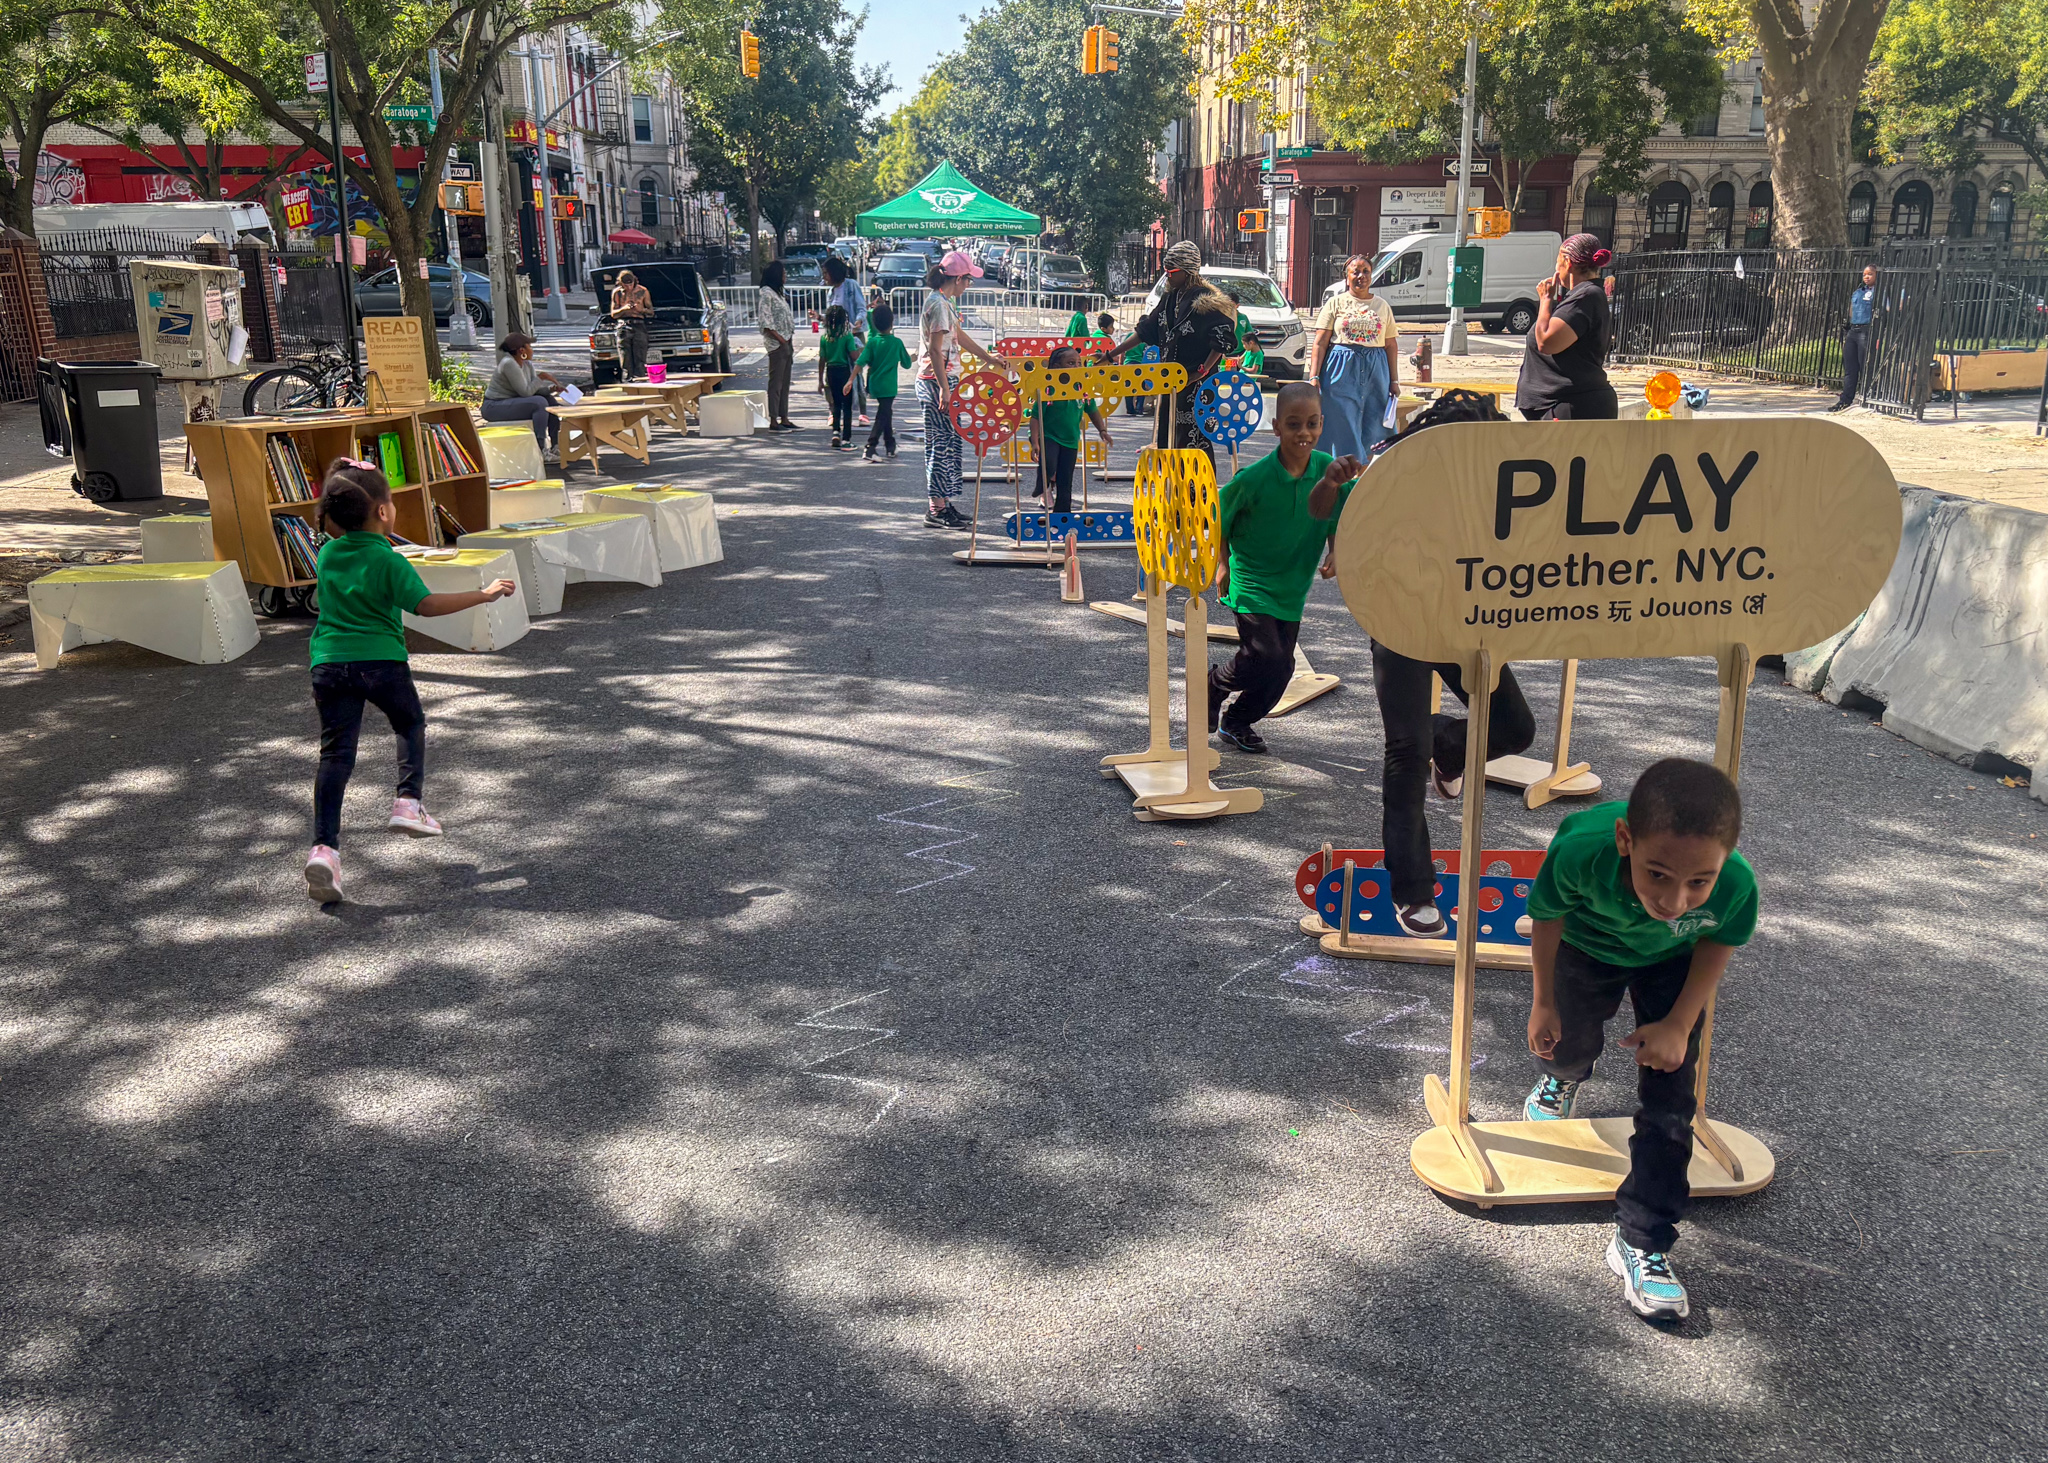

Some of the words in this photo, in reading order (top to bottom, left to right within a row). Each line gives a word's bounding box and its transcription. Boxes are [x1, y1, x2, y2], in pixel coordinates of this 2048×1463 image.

[1281, 149, 1303, 157] Saratoga
[1406, 190, 1427, 199] Deeper
[1428, 190, 1439, 198] Life
[287, 202, 309, 226] EBT
[873, 222, 906, 231] Together
[920, 222, 949, 230] STRIVE,
[949, 222, 982, 231] together
[367, 321, 418, 335] READ
[384, 363, 402, 371] Street
[1494, 450, 1759, 541] PLAY
[1456, 552, 1658, 598] Together.
[1675, 546, 1775, 583] NYC.
[1464, 603, 1599, 629] Juguemos
[1607, 600, 1632, 623] 玩
[1640, 597, 1733, 618] Jouons
